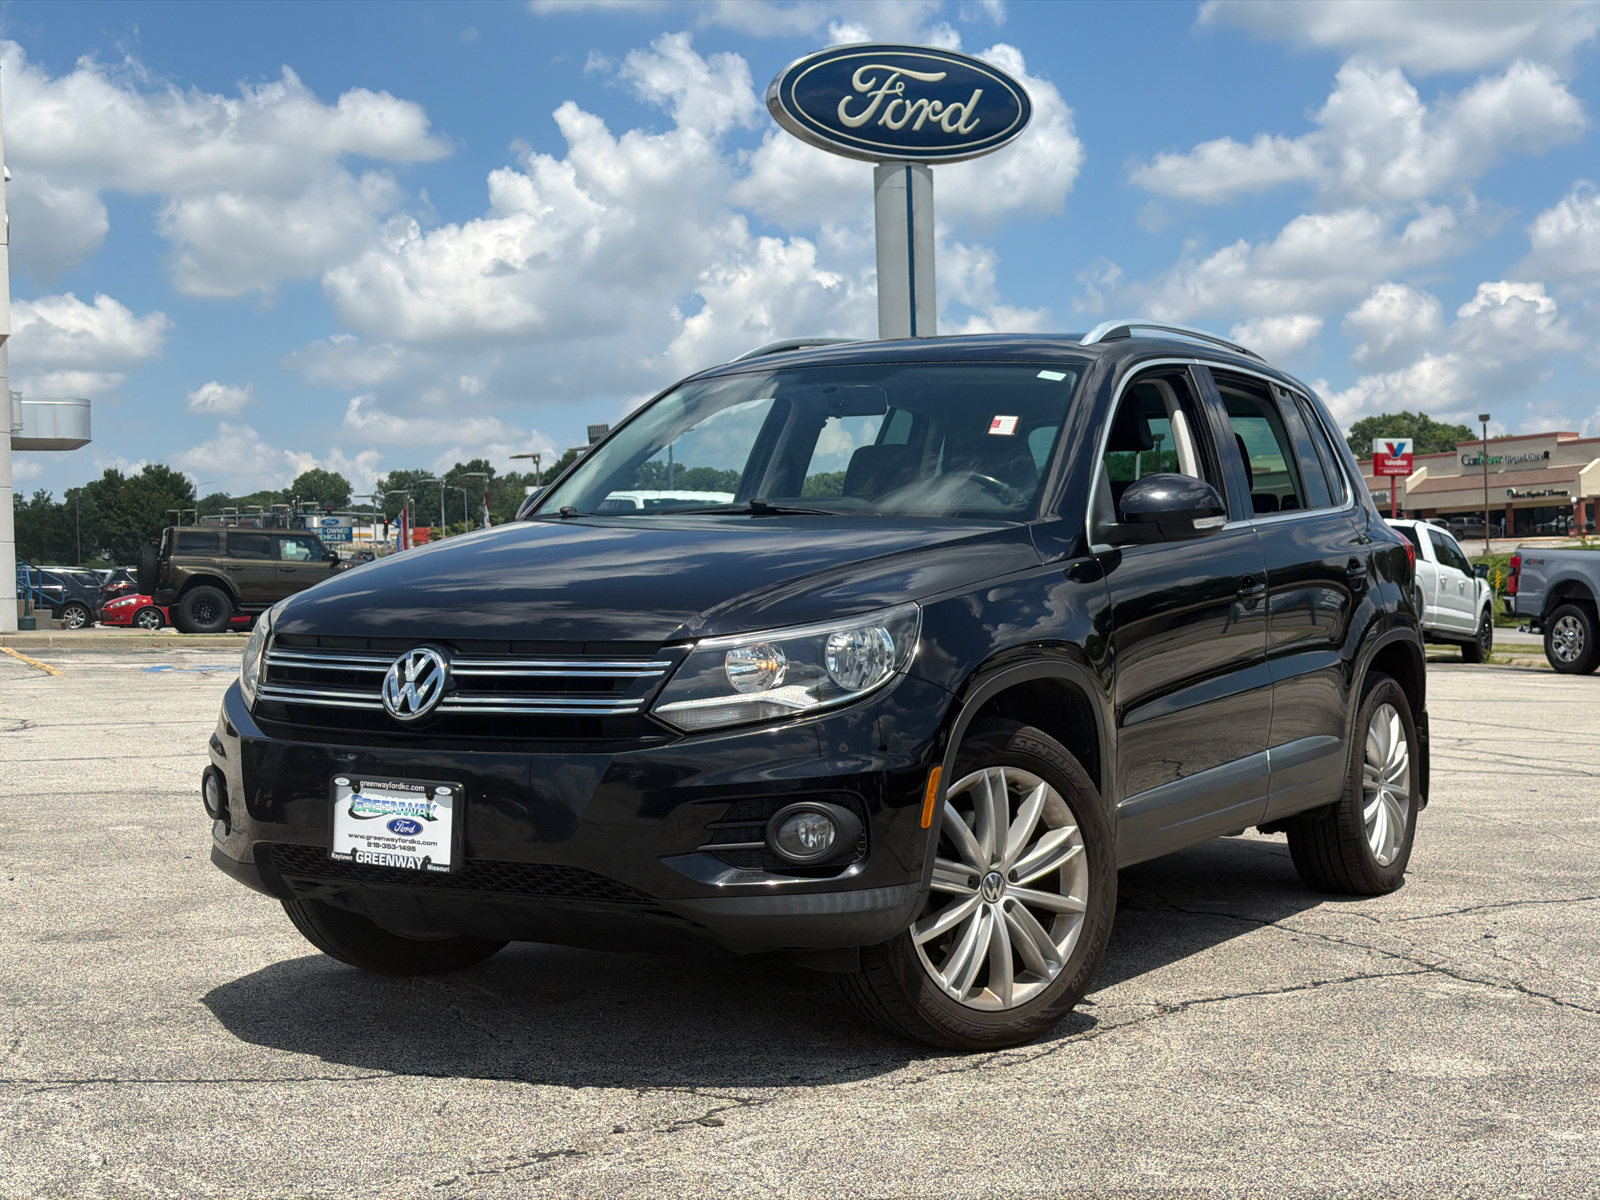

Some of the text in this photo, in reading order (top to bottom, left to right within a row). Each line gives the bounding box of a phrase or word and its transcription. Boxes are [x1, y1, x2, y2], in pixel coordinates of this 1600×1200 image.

[838, 64, 984, 135] Ford
[360, 780, 425, 792] greenwayfordkc.com
[351, 794, 438, 818] GREENWAY
[394, 820, 416, 834] Ford
[348, 833, 438, 846] www.greenwayfordkc.com
[331, 852, 353, 861] Raytown
[355, 850, 424, 870] GREENWAY
[427, 863, 450, 872] Missouri
